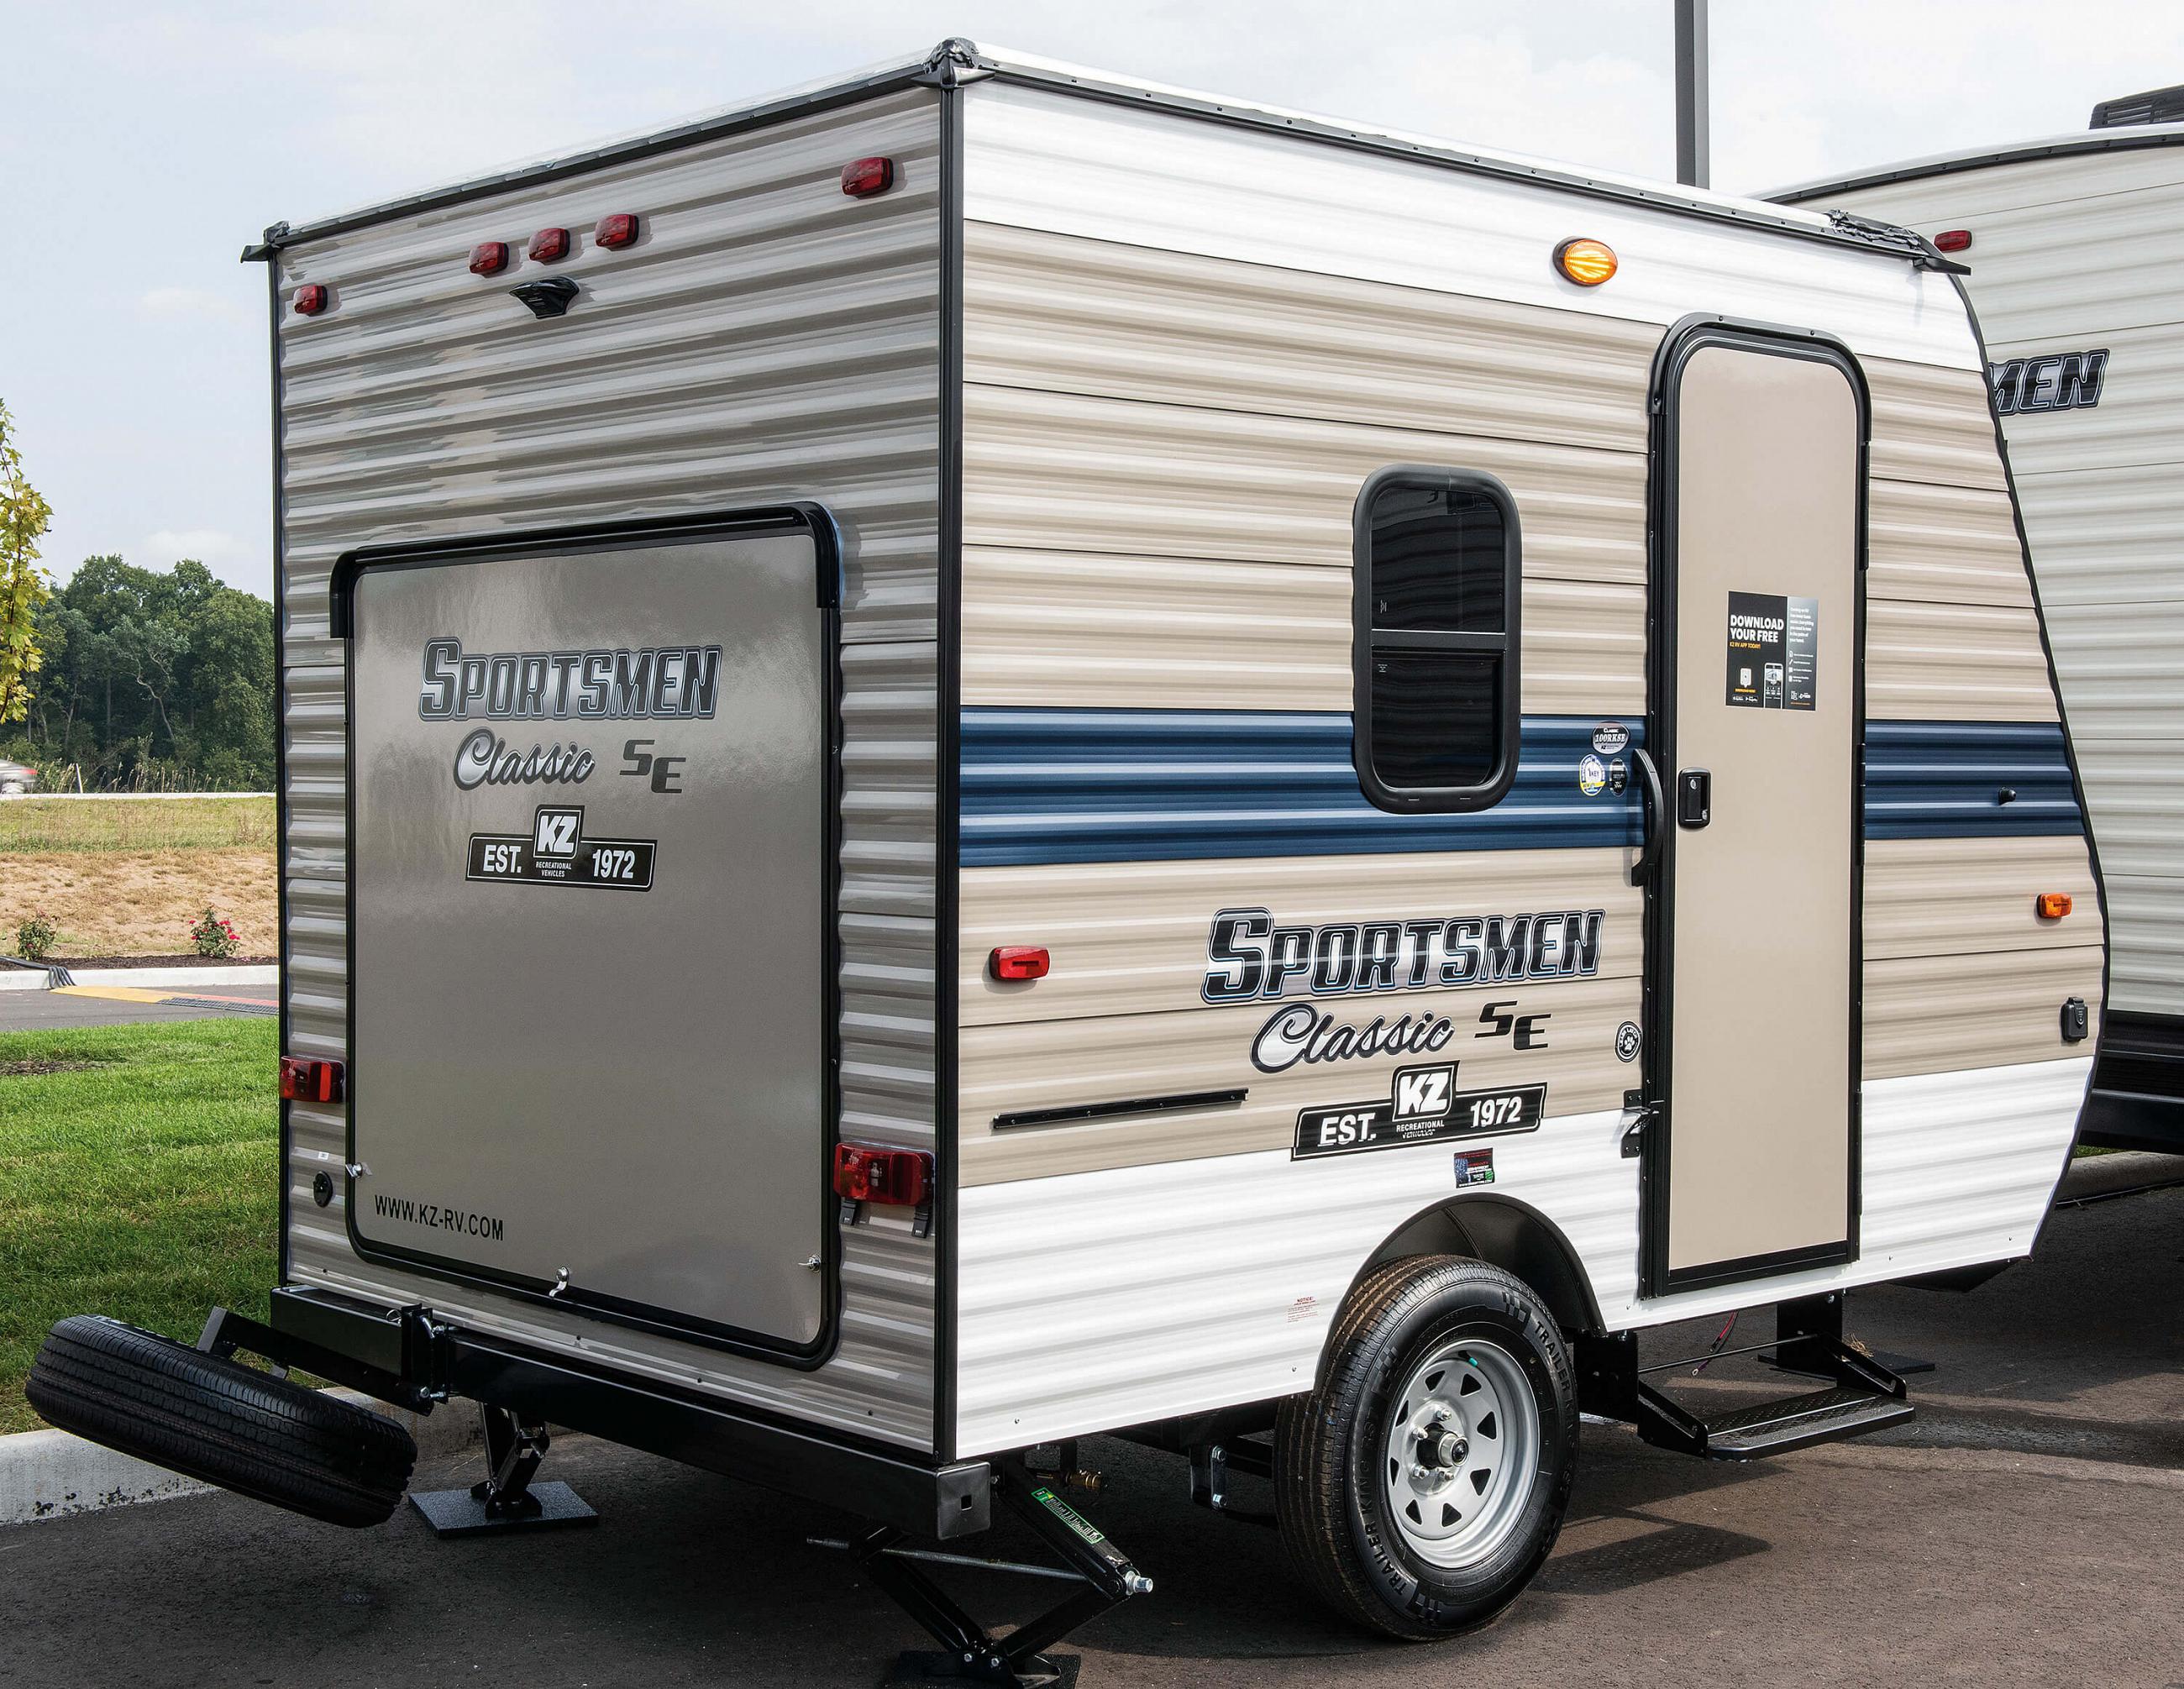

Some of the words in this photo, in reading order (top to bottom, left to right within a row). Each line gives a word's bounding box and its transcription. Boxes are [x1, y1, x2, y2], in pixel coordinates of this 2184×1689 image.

[1730, 615, 1784, 630] DOWNLOAD
[1730, 628, 1756, 641] YOUR
[1756, 630, 1778, 643] FREE
[453, 726, 595, 790] Classic
[619, 739, 686, 793] SE
[537, 814, 577, 853] KZ
[483, 844, 522, 873] EST.
[591, 849, 636, 879] 1972
[536, 861, 571, 869] RECREATIONAL
[541, 869, 565, 878] VEHICLES
[1249, 1003, 1455, 1073] Classic
[1474, 1000, 1551, 1050] SE
[1398, 1072, 1450, 1115] KZ
[1317, 1113, 1376, 1147] EST.
[1470, 1096, 1523, 1128] 1972
[1396, 1120, 1445, 1132] RECREATIONAL
[375, 1194, 504, 1241] WWW.KZ-RV.COM
[1535, 1321, 1570, 1391] TRAILER
[1364, 1521, 1408, 1596] TRAILER
